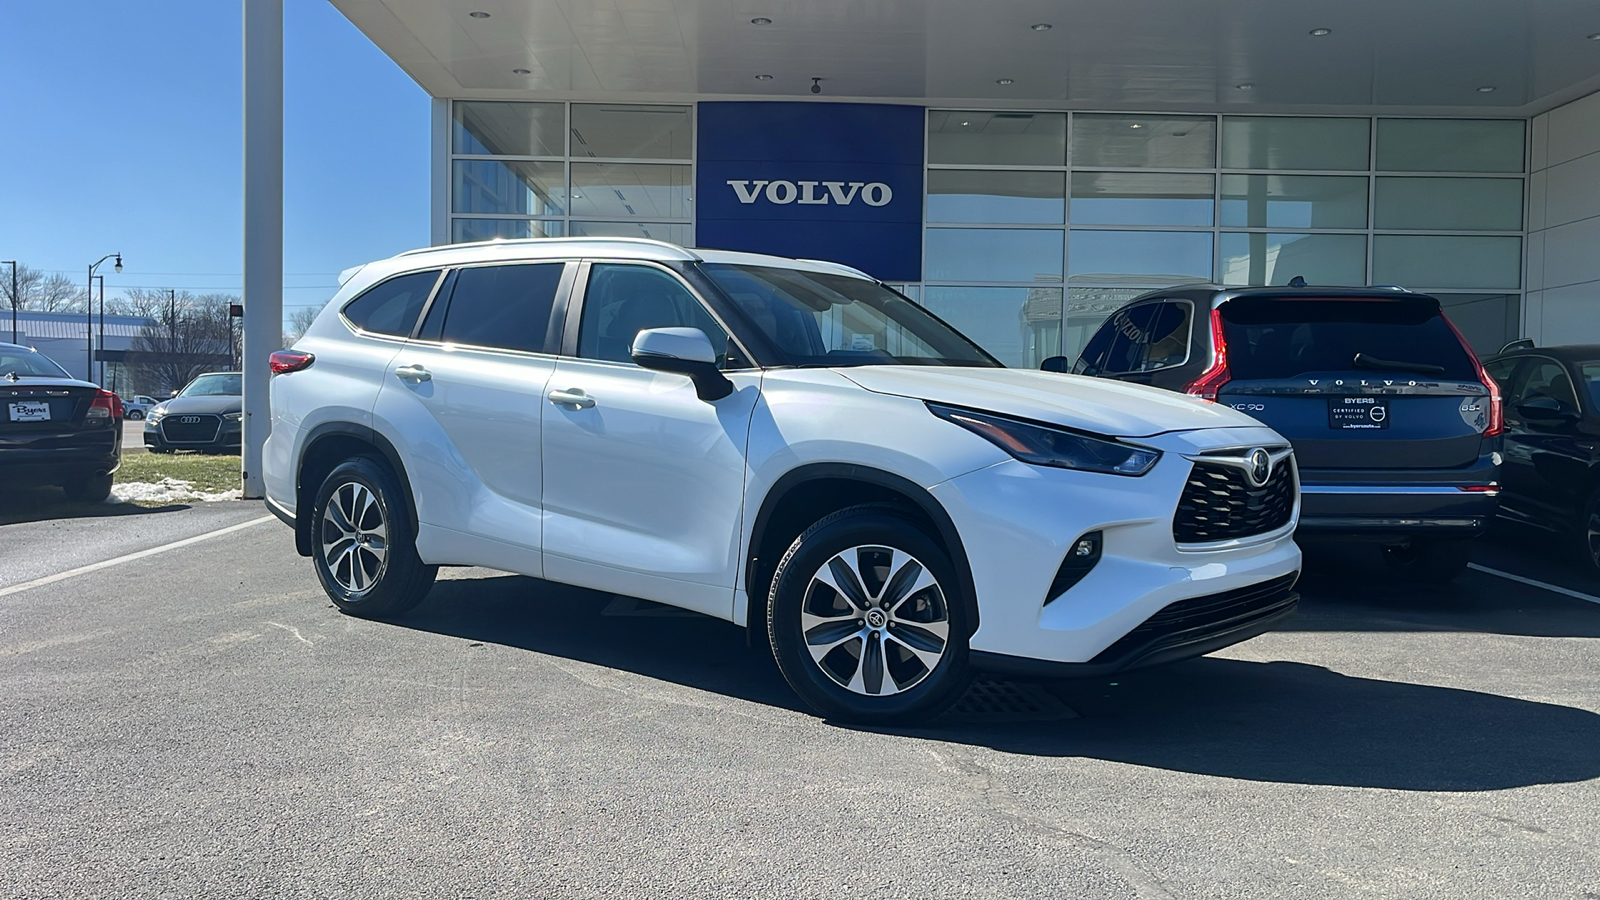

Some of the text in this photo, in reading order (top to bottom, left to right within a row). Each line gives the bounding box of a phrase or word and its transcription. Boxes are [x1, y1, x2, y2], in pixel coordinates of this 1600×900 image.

[726, 180, 893, 207] VOLVO
[1308, 379, 1417, 387] VOLVO
[12, 405, 47, 416] Byers
